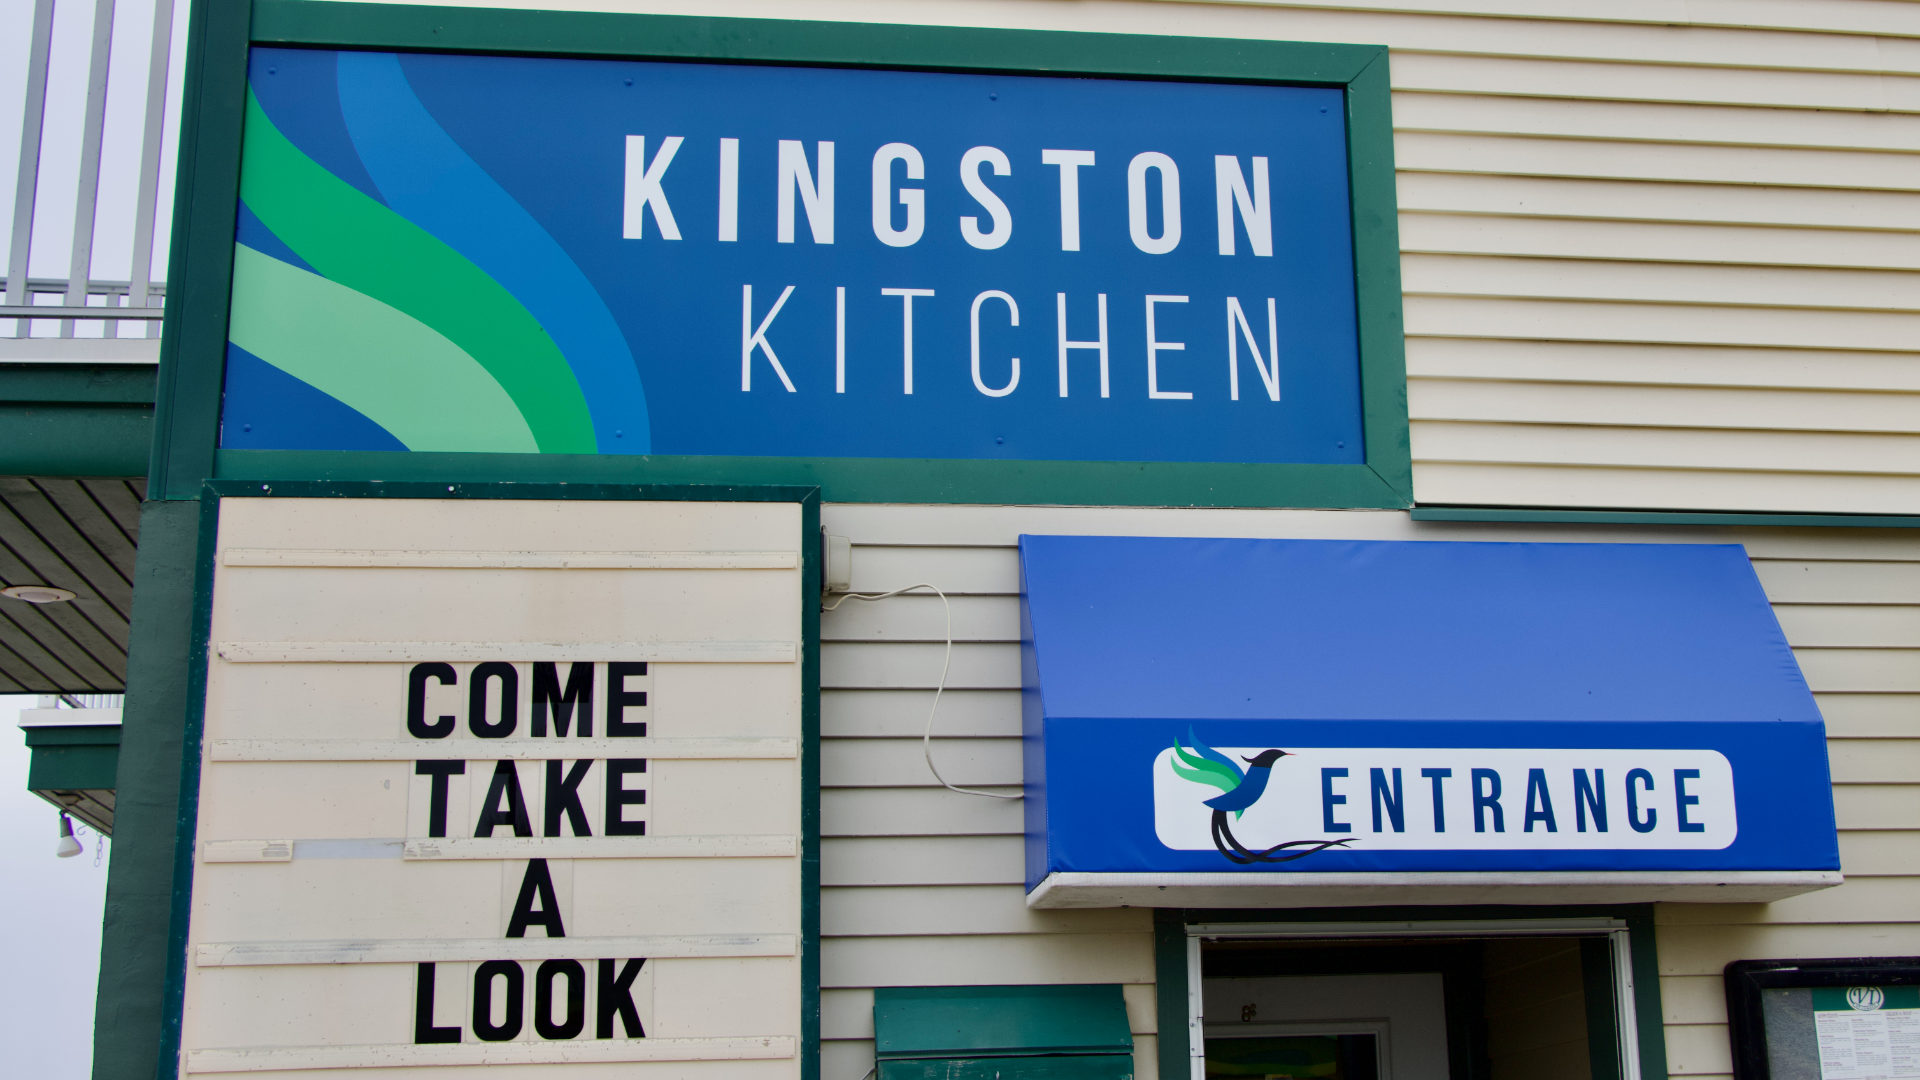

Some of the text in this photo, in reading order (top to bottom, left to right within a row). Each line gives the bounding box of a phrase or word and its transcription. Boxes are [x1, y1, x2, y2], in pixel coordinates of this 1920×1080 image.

[622, 134, 1273, 257] KINGSTON
[741, 284, 1281, 402] KITCHEN
[407, 661, 648, 739] COME
[415, 758, 647, 838] TAKE
[1320, 767, 1705, 834] ENTRANCE
[505, 857, 566, 938] A
[414, 957, 648, 1045] LOOK
